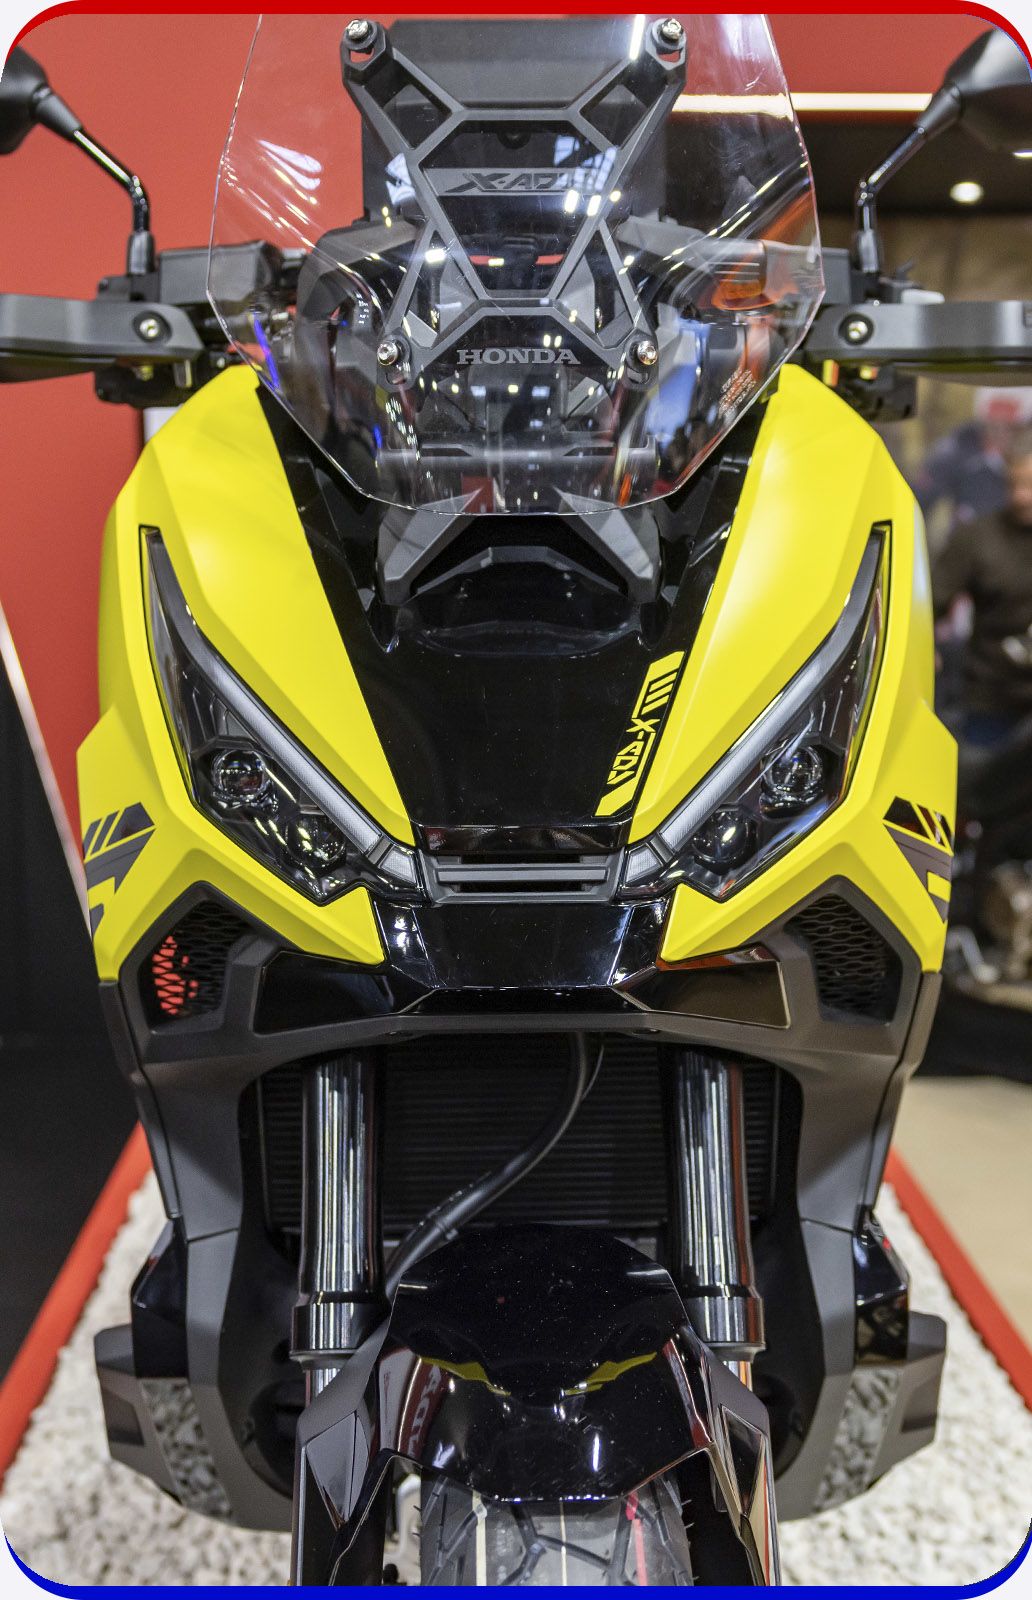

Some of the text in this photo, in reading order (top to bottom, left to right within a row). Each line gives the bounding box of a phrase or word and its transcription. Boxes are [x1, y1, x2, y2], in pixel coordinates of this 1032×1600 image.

[445, 173, 588, 193] X-AD
[456, 347, 581, 365] HONDA
[606, 719, 661, 785] X-ADV
